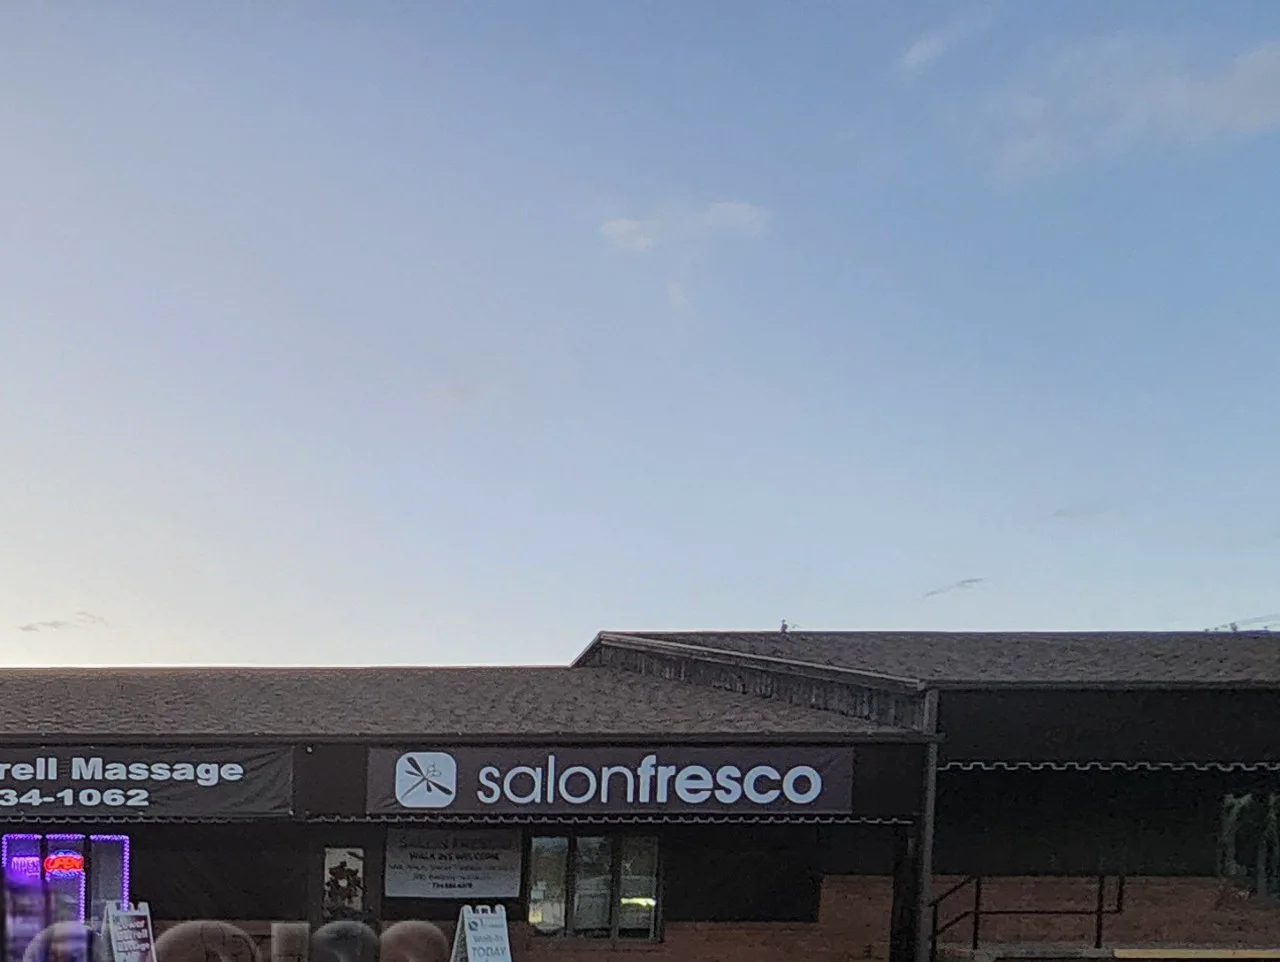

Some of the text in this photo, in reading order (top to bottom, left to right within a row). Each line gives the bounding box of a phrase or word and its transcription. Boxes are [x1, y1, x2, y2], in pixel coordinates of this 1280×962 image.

[70, 757, 244, 786] Massage
[476, 754, 822, 804] salonfresco
[44, 855, 84, 871] OPEN
[472, 946, 507, 957] TODAY
